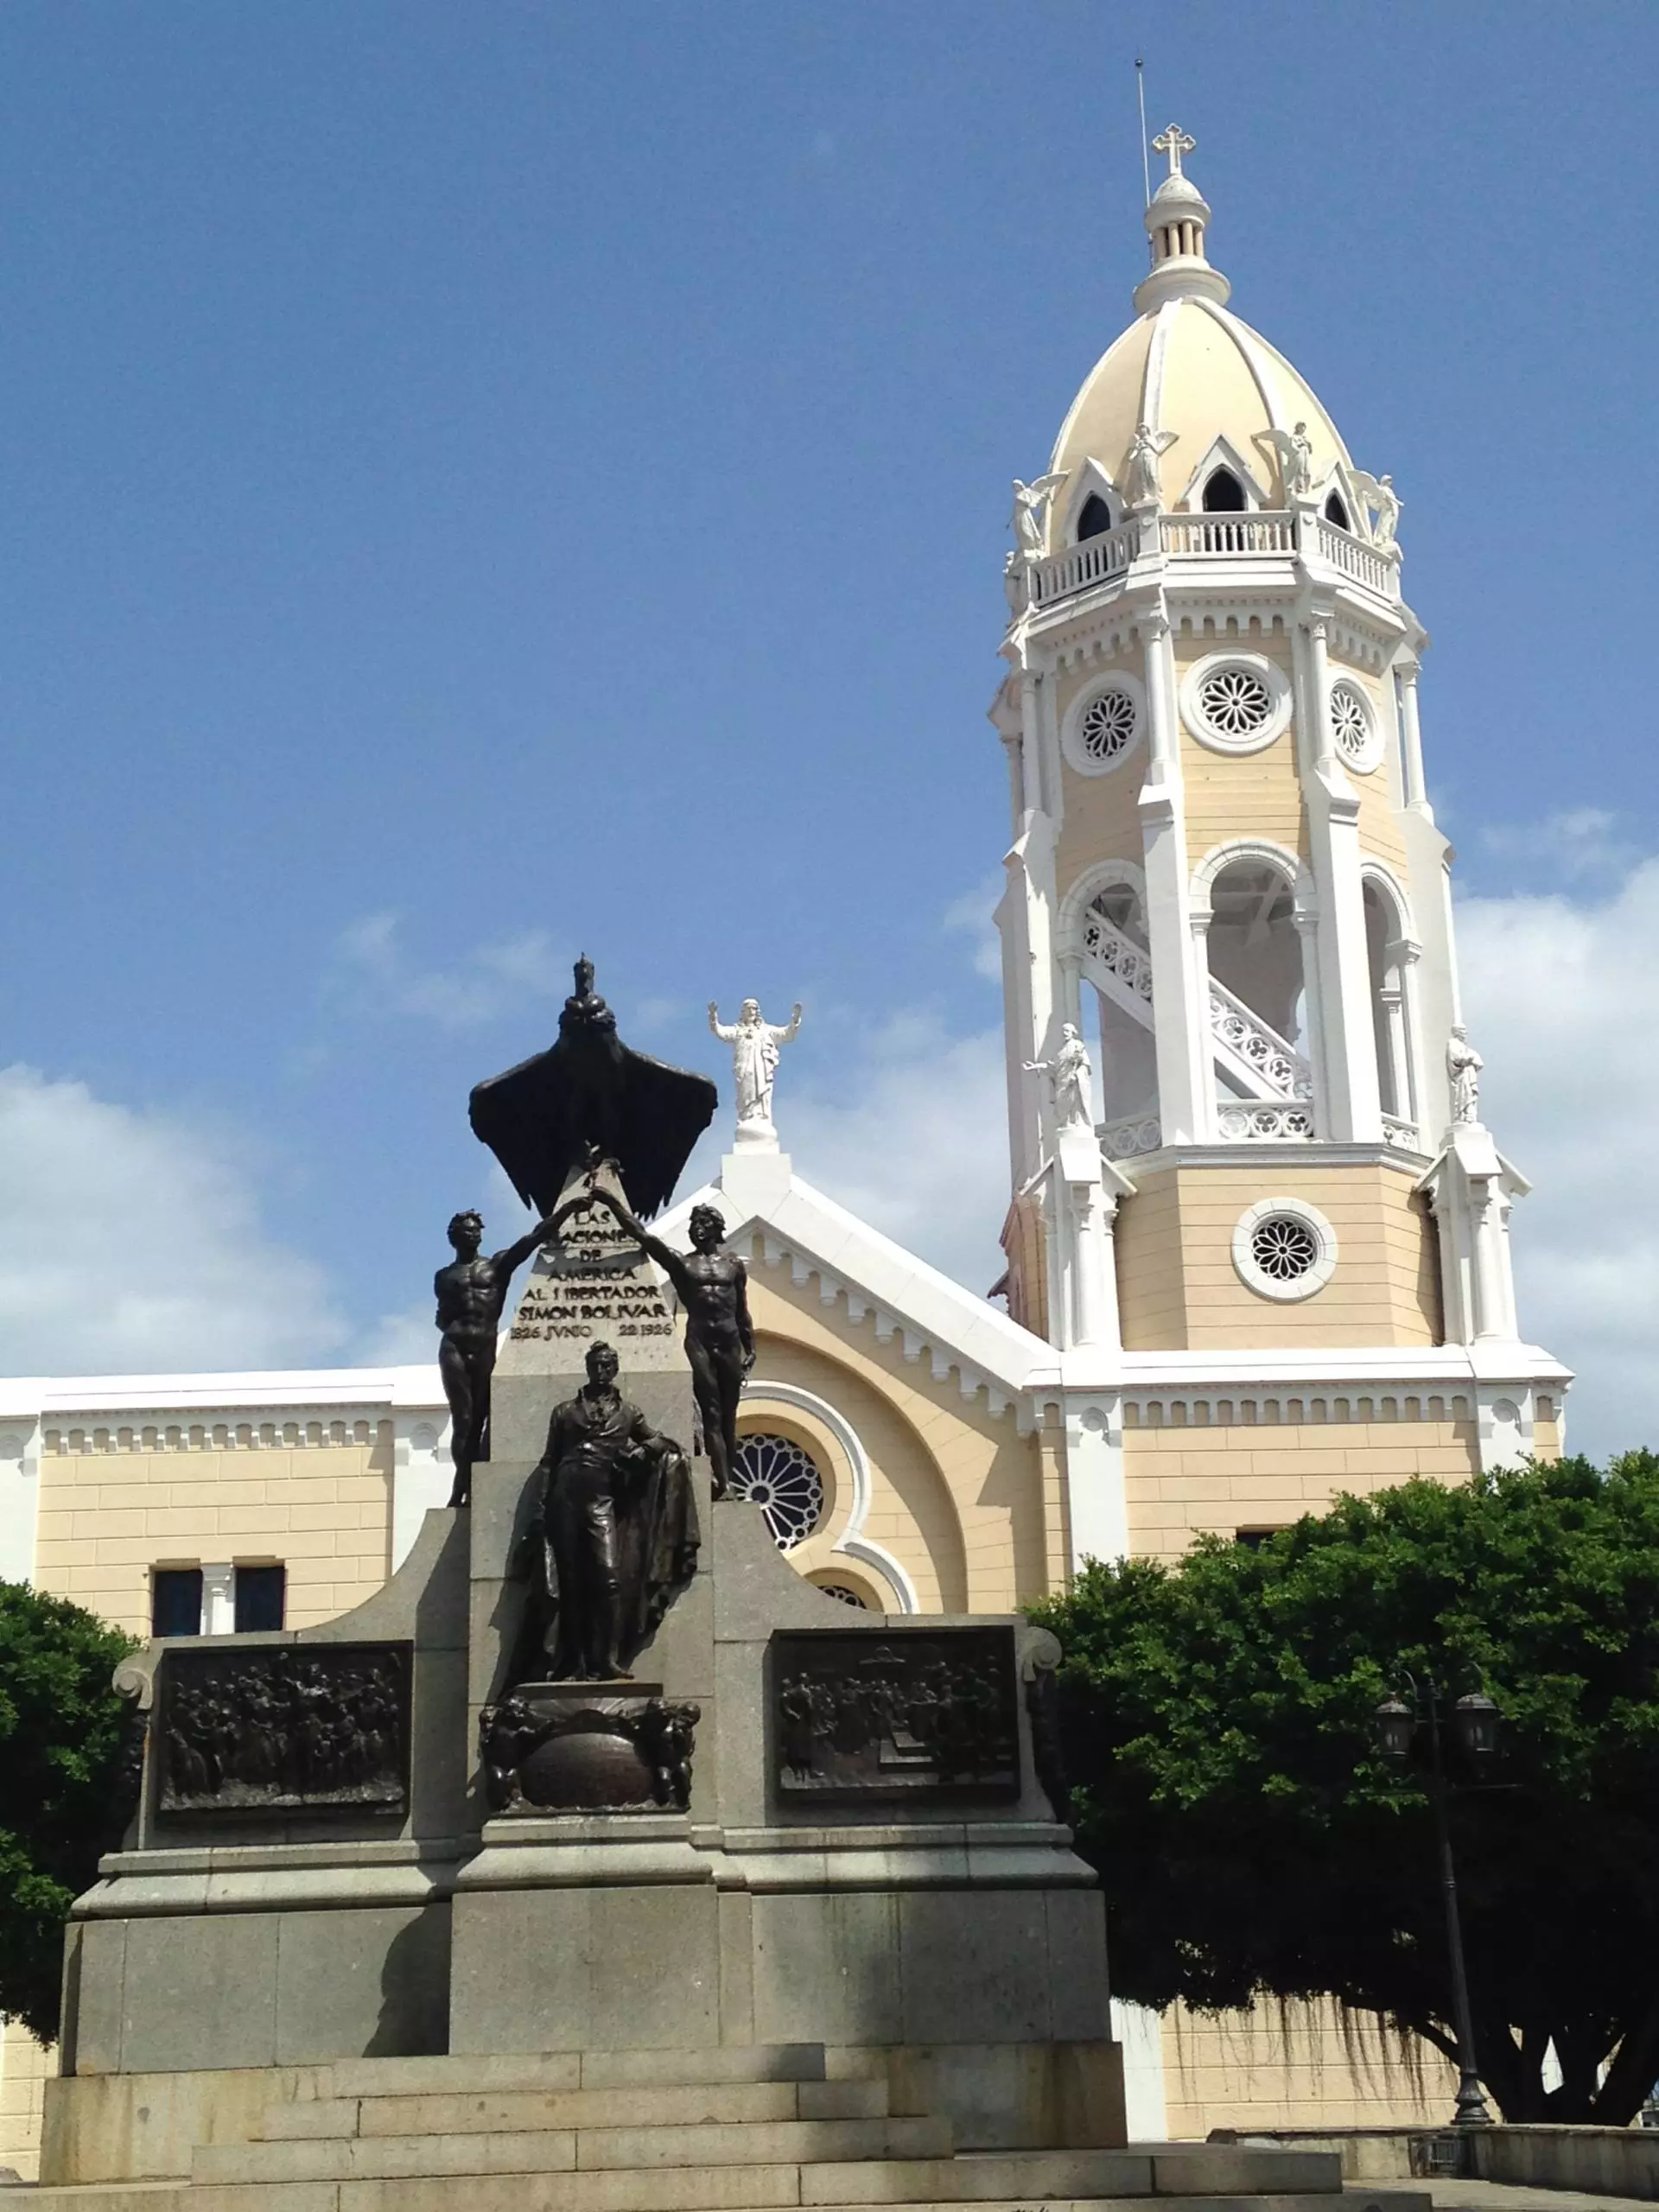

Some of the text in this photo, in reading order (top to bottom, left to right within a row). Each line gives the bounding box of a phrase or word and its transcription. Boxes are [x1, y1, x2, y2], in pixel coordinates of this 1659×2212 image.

[575, 1211, 610, 1225] LAS
[580, 1249, 601, 1262] DE
[547, 1267, 638, 1282] AMERICA
[523, 1285, 661, 1300] AL LIBERTADOR
[518, 1303, 668, 1321] SIMON BOLIVAR
[618, 1324, 638, 1337] 22
[640, 1323, 672, 1337] 1926
